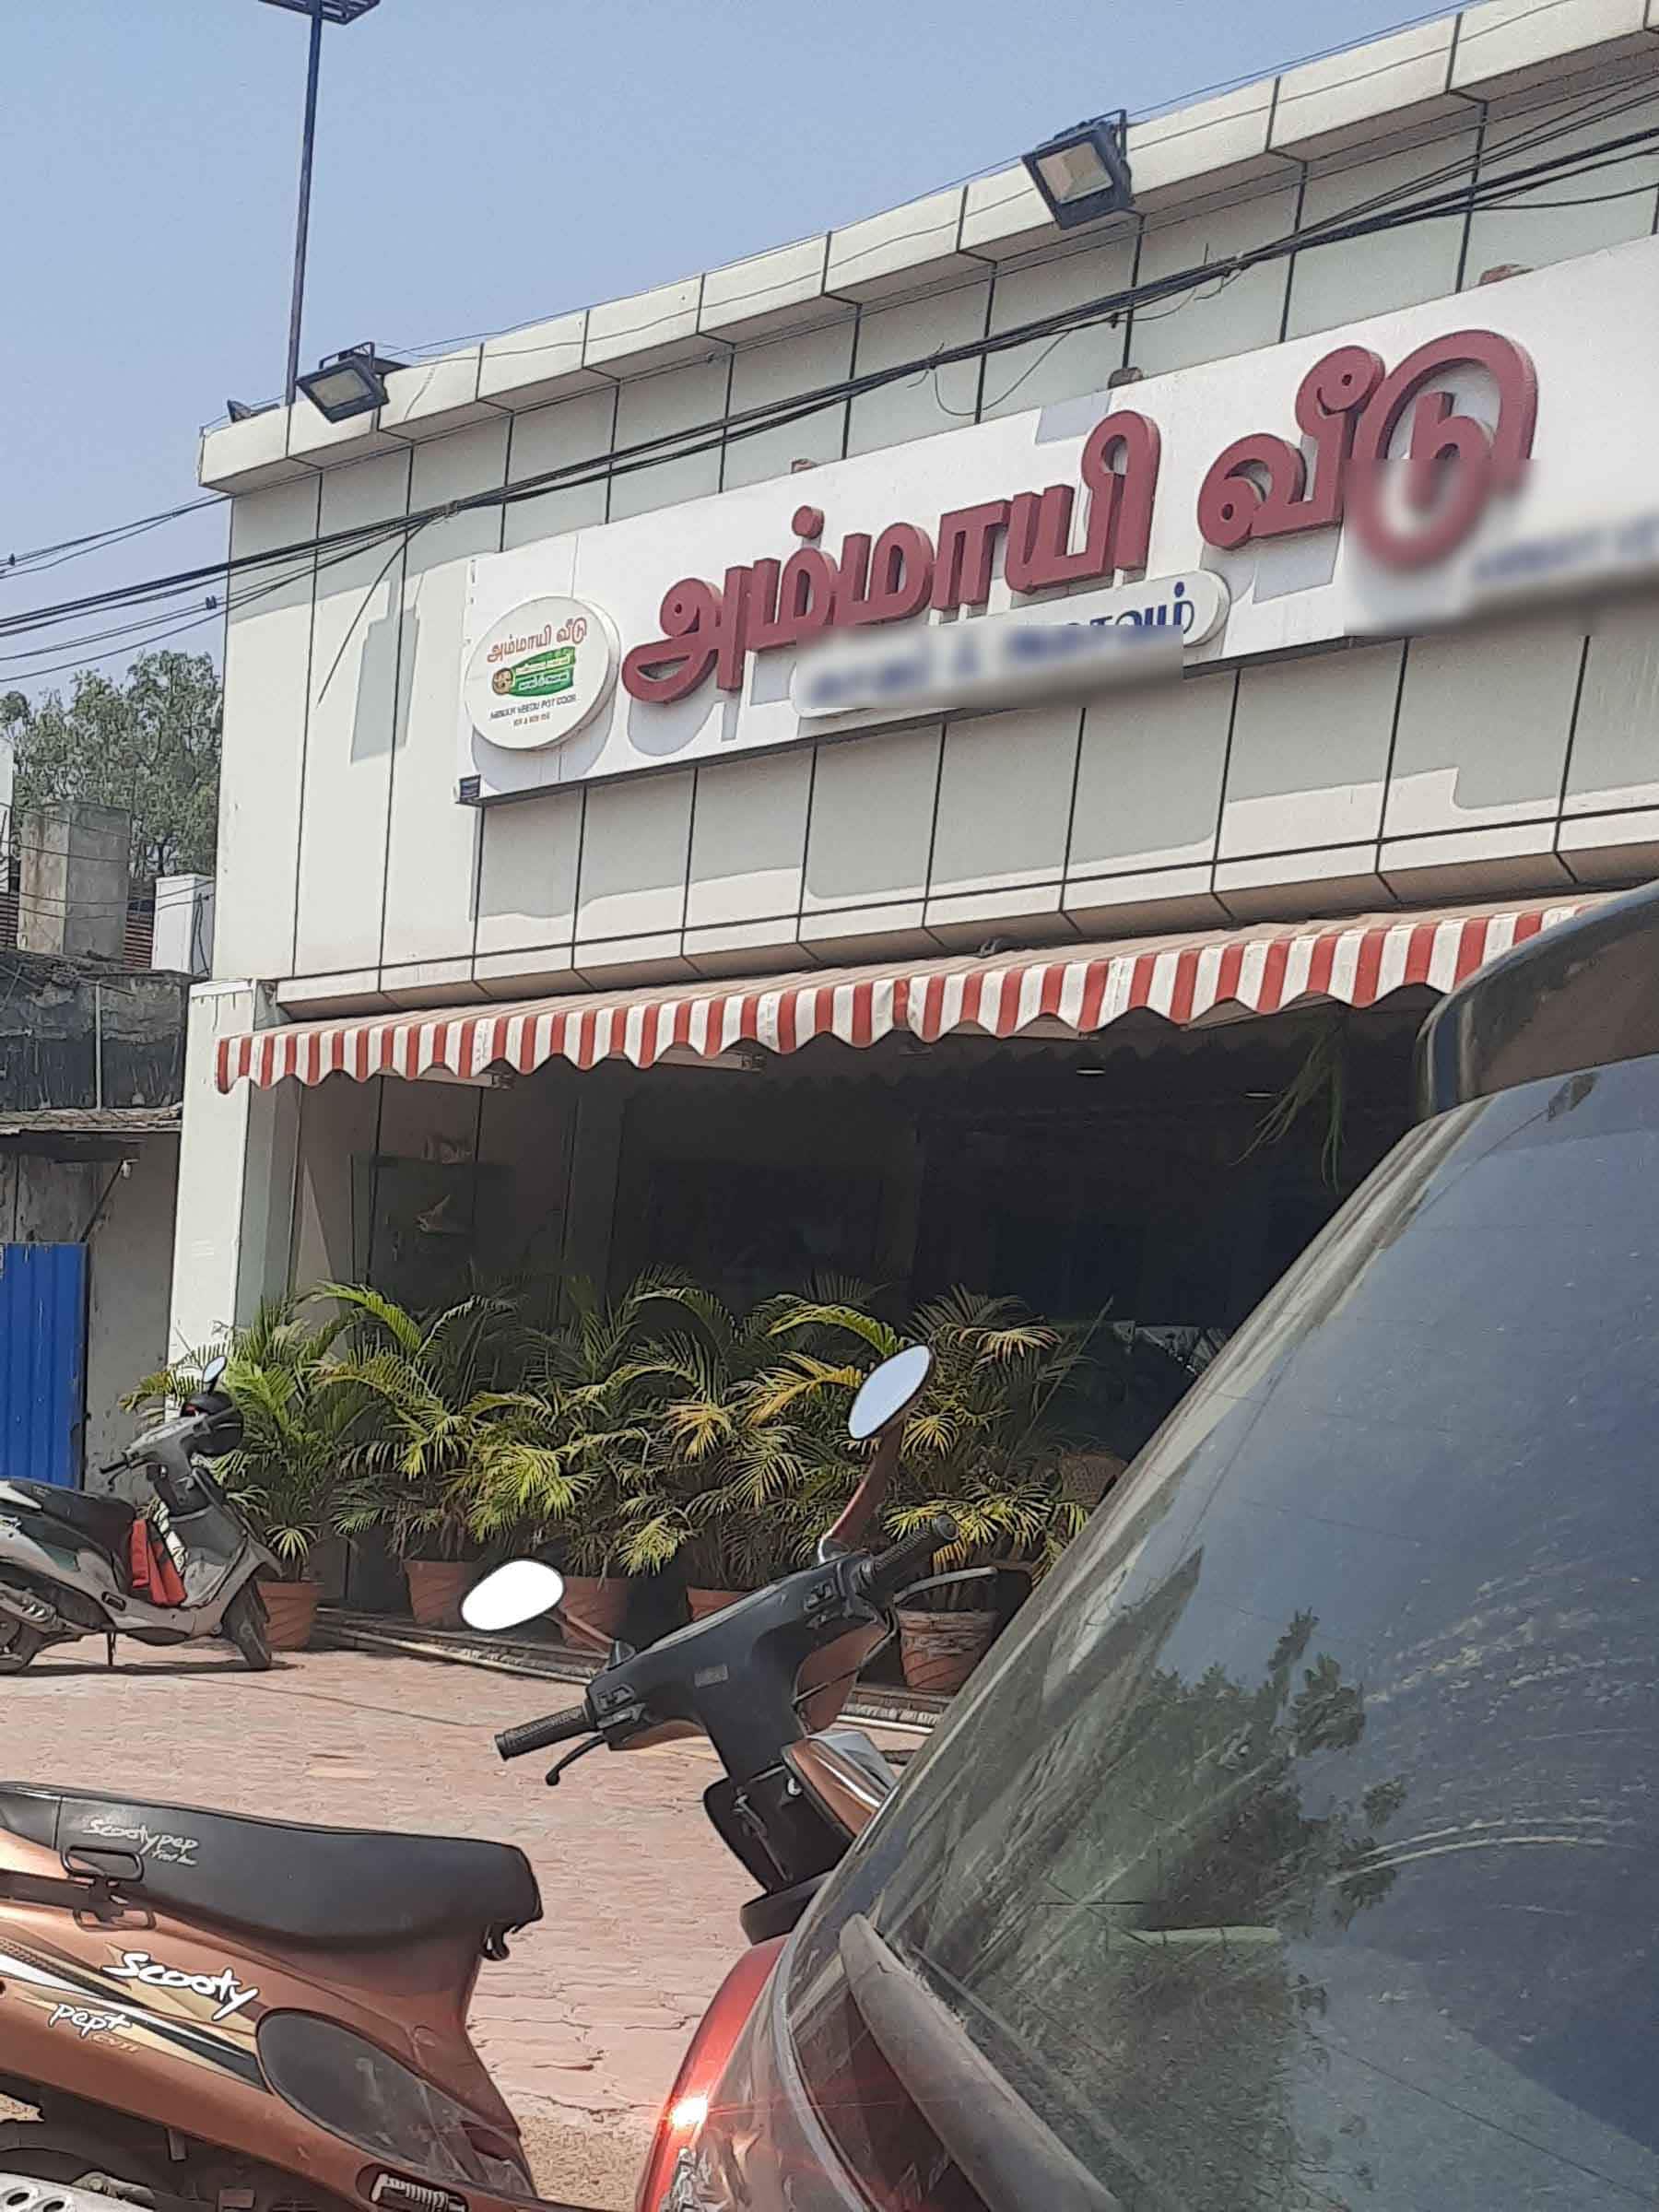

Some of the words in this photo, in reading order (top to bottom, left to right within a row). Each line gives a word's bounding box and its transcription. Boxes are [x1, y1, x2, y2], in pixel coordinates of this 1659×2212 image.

[622, 410, 1161, 703] அம்மாயி
[487, 624, 552, 663] அம்மாயி
[556, 617, 587, 644] வீடு
[102, 1952, 259, 2021] Scooty
